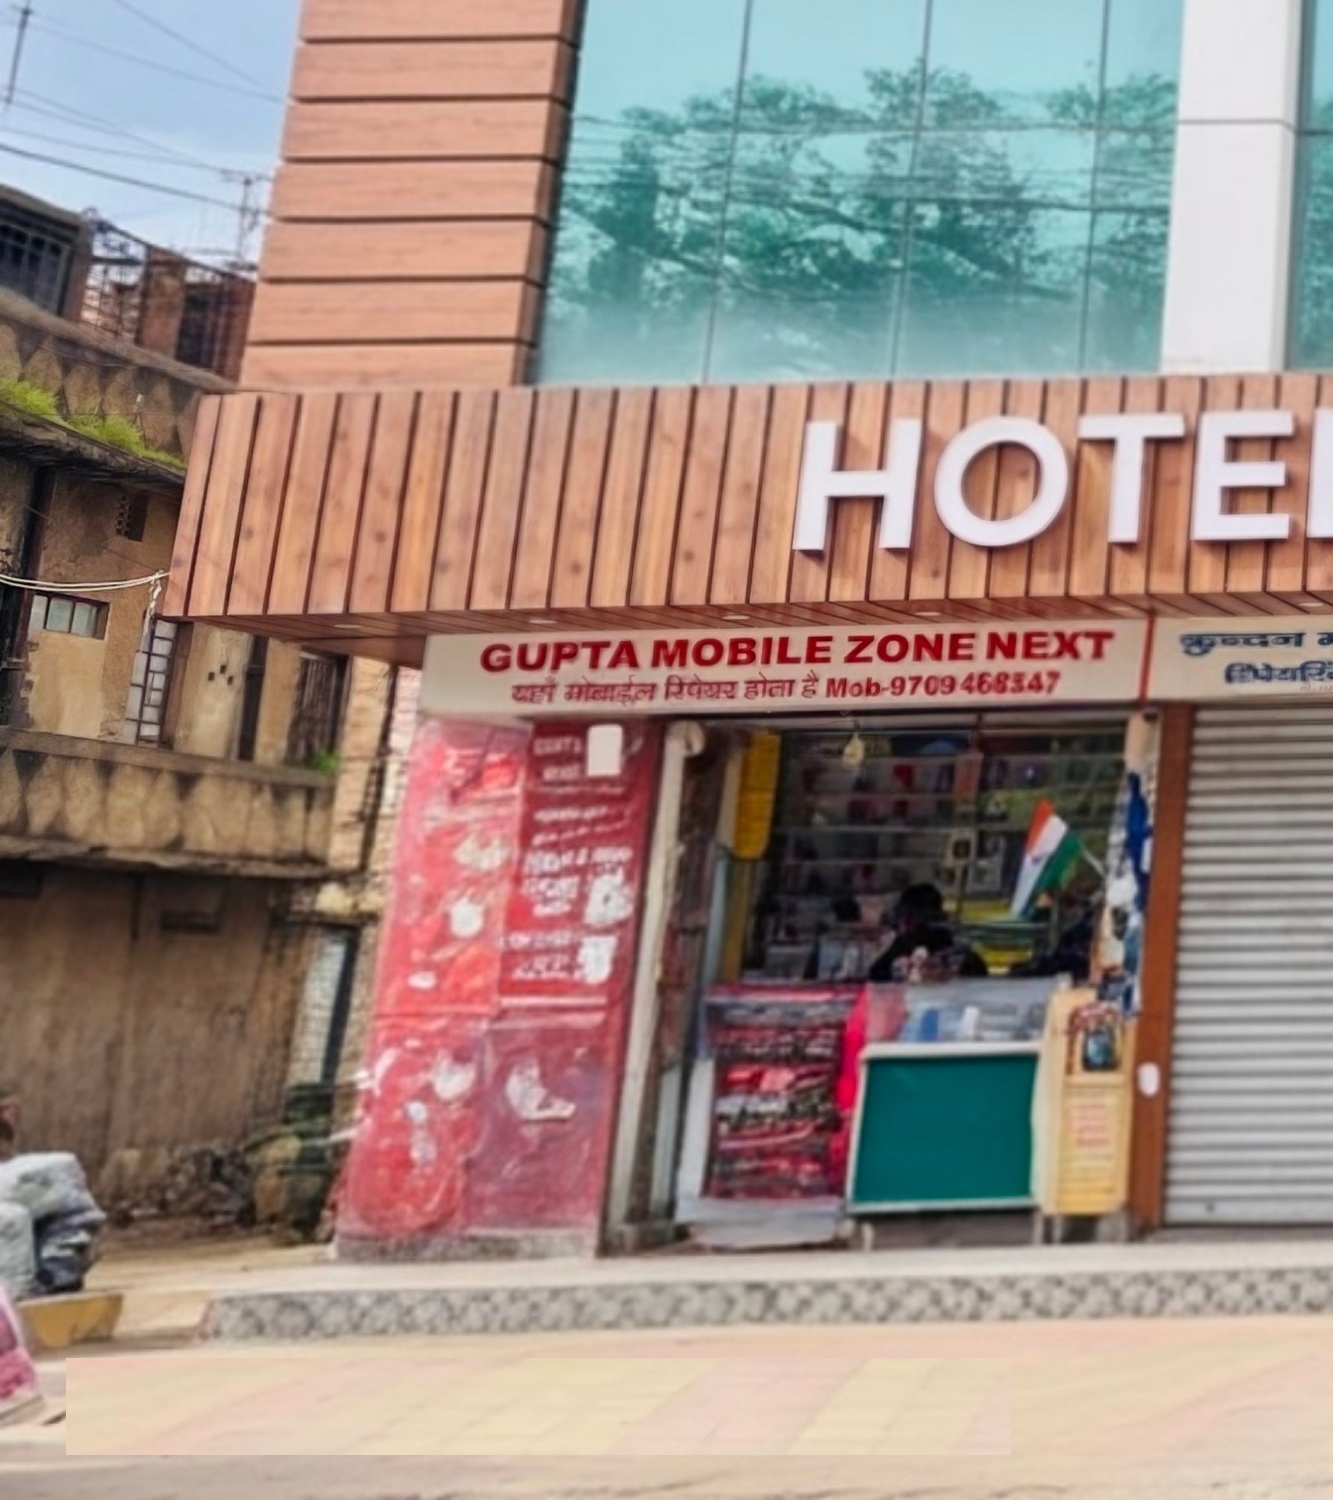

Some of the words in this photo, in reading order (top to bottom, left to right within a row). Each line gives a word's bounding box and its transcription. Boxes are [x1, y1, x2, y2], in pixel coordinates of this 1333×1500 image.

[480, 639, 639, 673] GUPTA
[651, 635, 833, 669] MOBILE
[843, 631, 976, 664] ZONE
[986, 630, 1115, 661] NEXT
